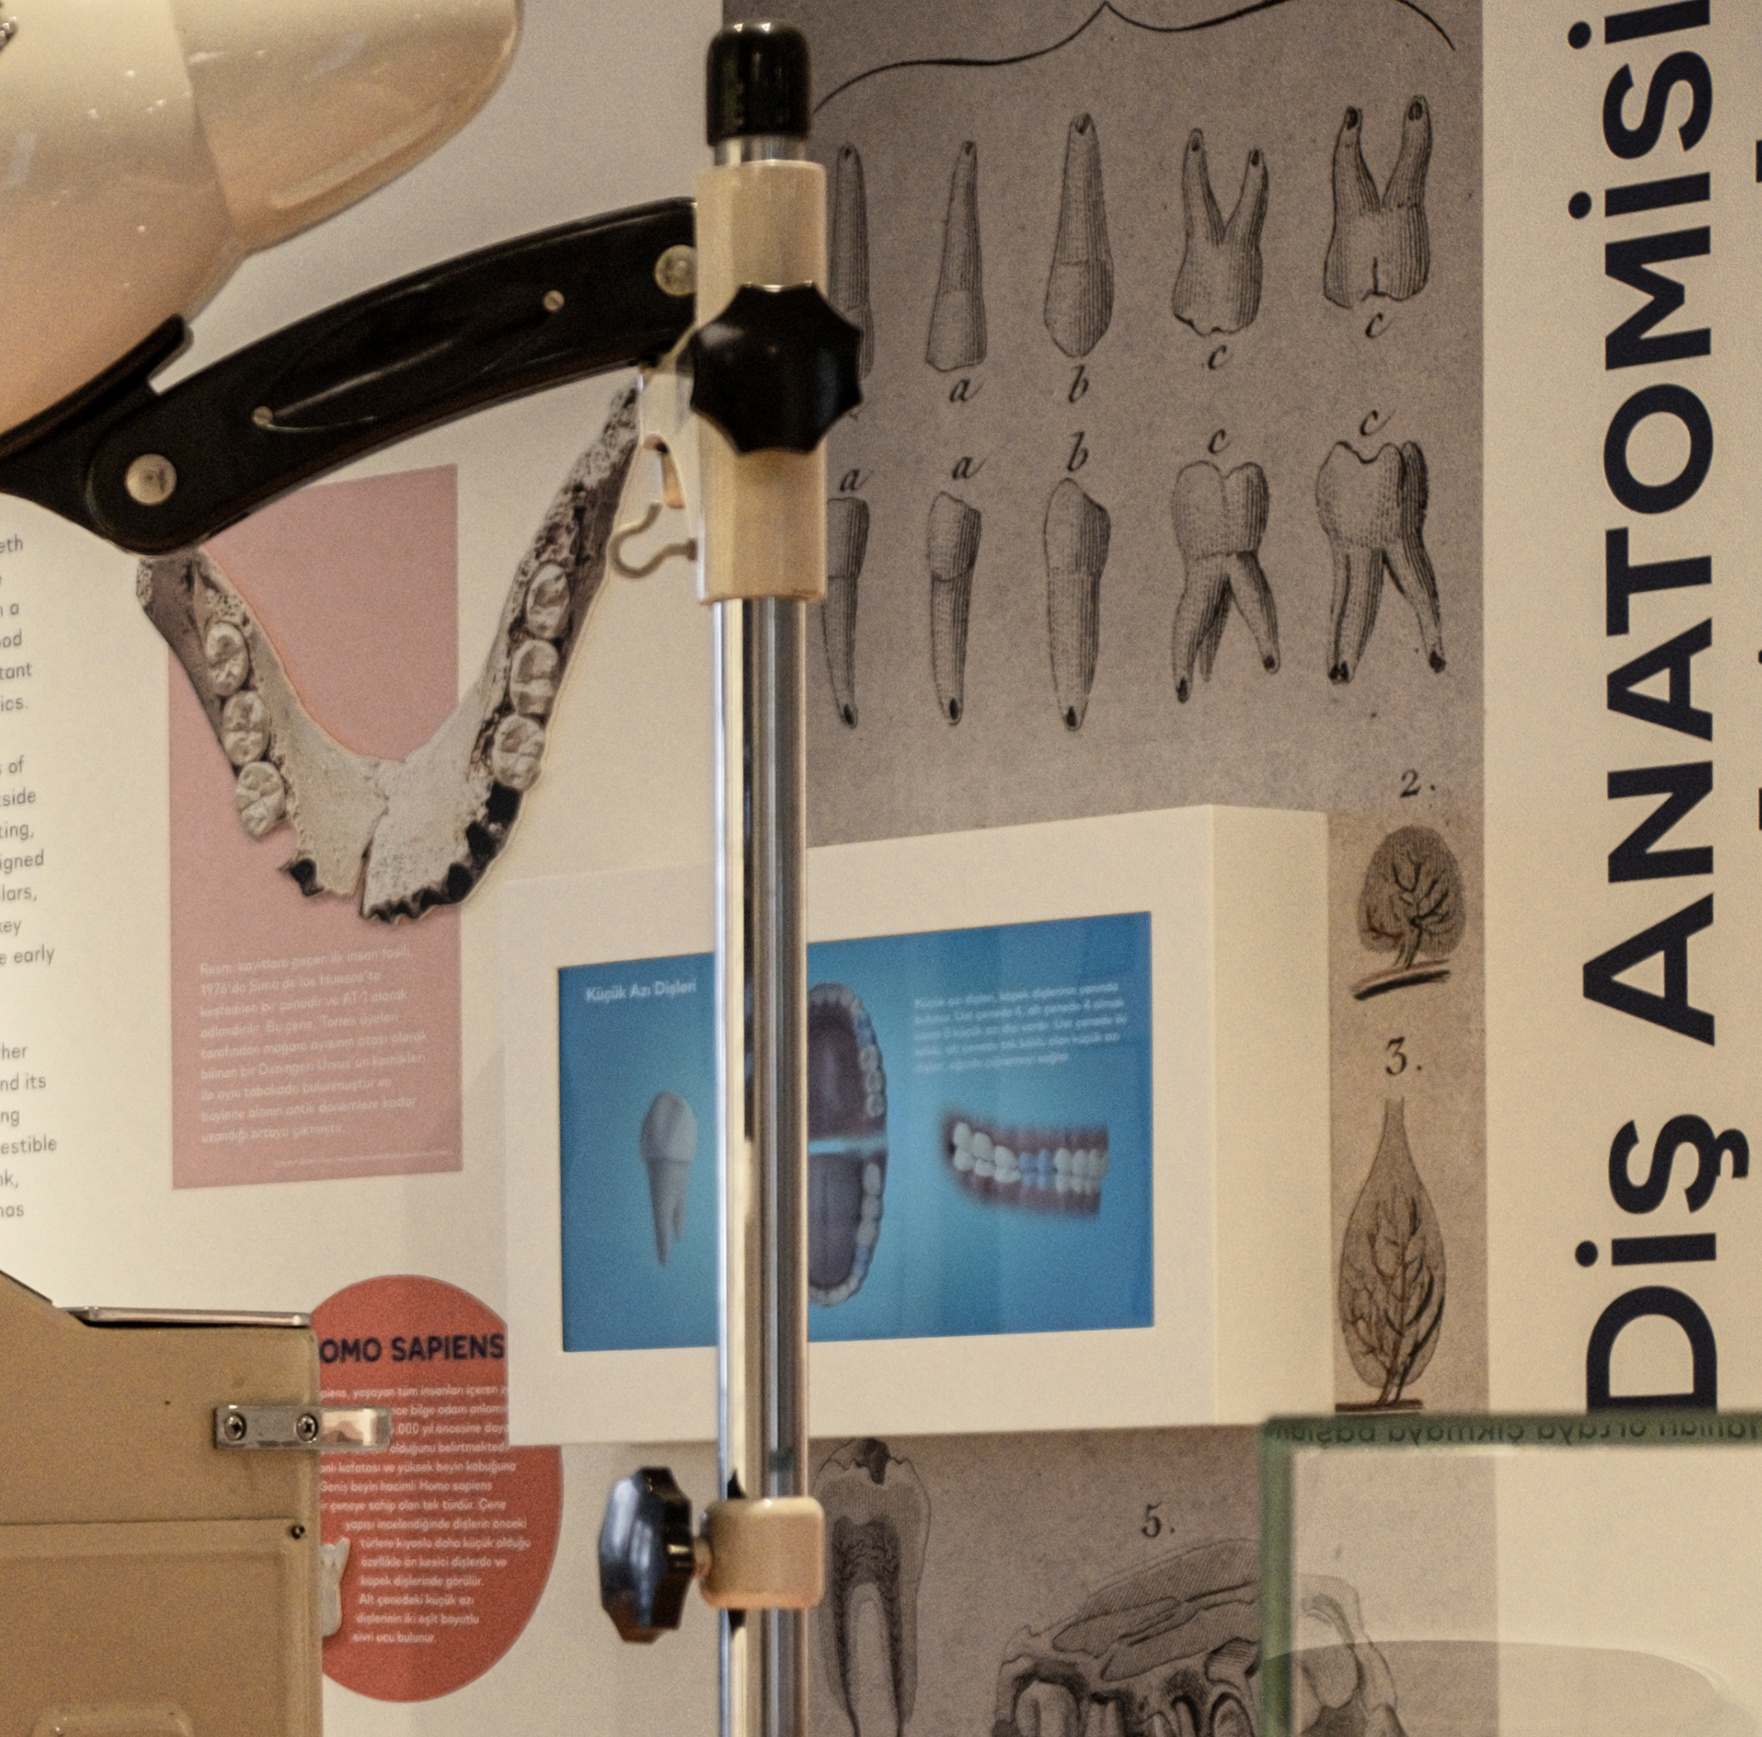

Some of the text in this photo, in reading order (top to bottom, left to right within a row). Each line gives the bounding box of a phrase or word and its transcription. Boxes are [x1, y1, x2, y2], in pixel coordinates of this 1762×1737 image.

[1364, 312, 1384, 340] c
[1205, 344, 1233, 372] c
[948, 376, 978, 404] a
[1067, 363, 1090, 404] b
[1358, 409, 1383, 438] c
[1065, 430, 1089, 473] b
[1206, 428, 1227, 456] c
[838, 468, 864, 492] a
[949, 455, 978, 481] a
[1399, 769, 1436, 799] 2.
[585, 979, 697, 1004] Küçük Azı Dişleri
[1385, 1035, 1423, 1076] 3.
[391, 1333, 504, 1362] SAPIENS
[1140, 1503, 1175, 1539] 5.
